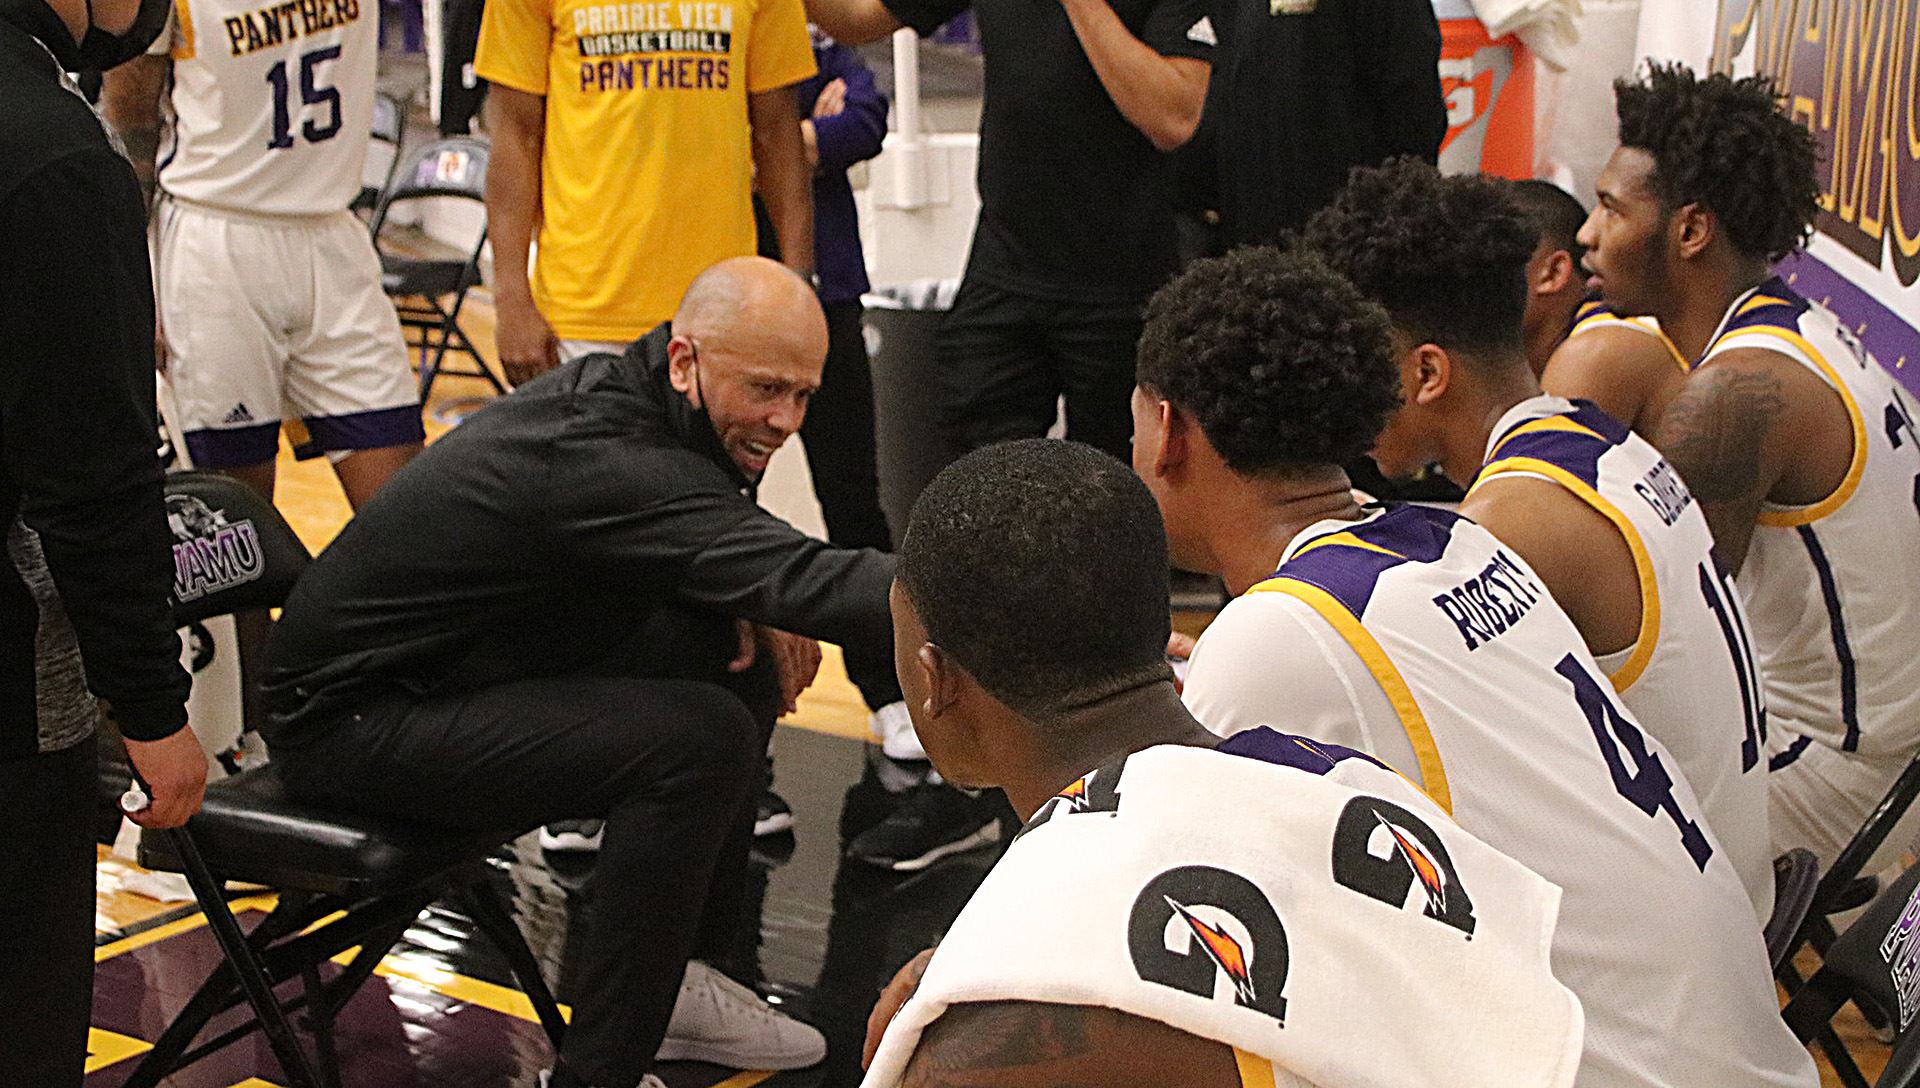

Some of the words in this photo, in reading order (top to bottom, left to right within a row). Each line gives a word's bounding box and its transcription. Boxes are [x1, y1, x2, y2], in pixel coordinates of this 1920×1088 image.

[573, 3, 673, 36] PRAIRIE
[679, 1, 733, 31] VIEW
[582, 30, 725, 56] BASKETBALL
[580, 57, 729, 92] PANTHERS
[266, 44, 342, 150] 15
[1554, 652, 1713, 874] 4
